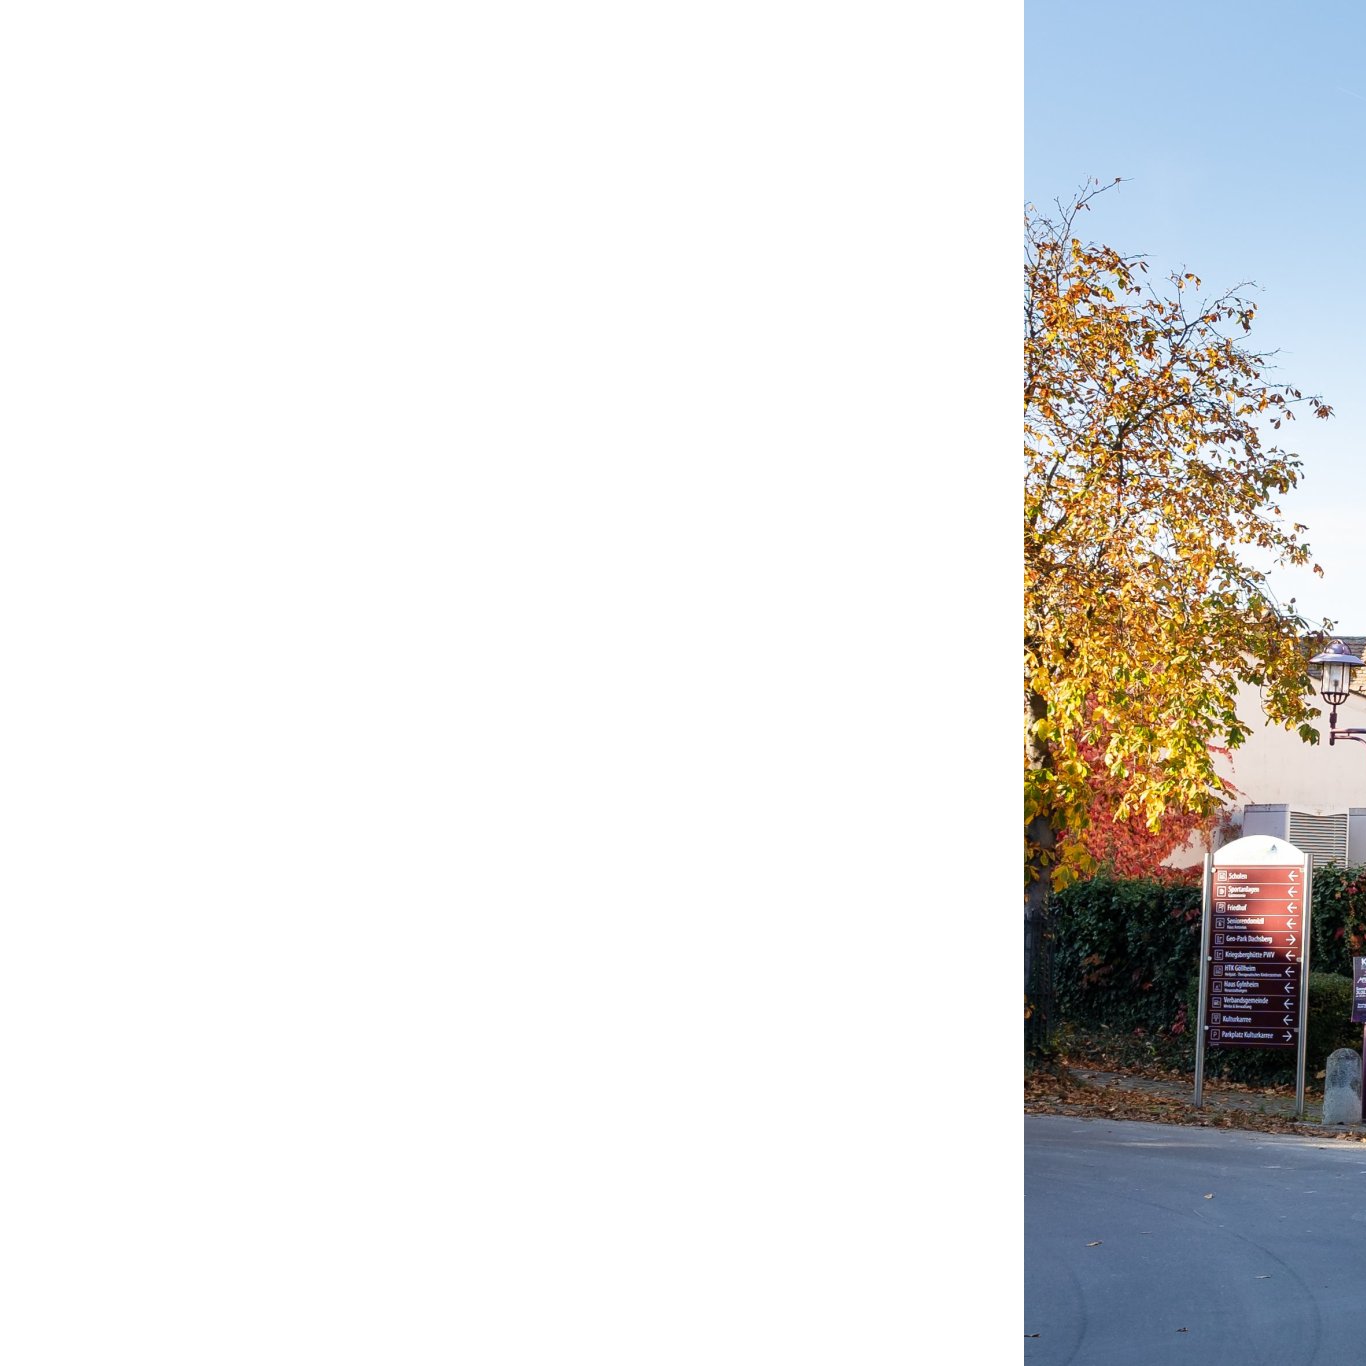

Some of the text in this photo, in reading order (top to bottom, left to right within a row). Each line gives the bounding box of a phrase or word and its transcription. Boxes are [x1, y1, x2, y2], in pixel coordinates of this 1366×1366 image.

[1227, 886, 1260, 894] Sportanlagen
[1227, 903, 1247, 911] Friedhof
[1247, 935, 1273, 944] Dachsberg
[1225, 951, 1276, 960] Kriegsberghütte PWV
[1223, 997, 1268, 1005] Verbandsgemeinde
[1222, 1015, 1252, 1023] Kulturkarree
[1221, 1030, 1243, 1039] Parkplatz
[1243, 1031, 1274, 1039] Kulturkarree
